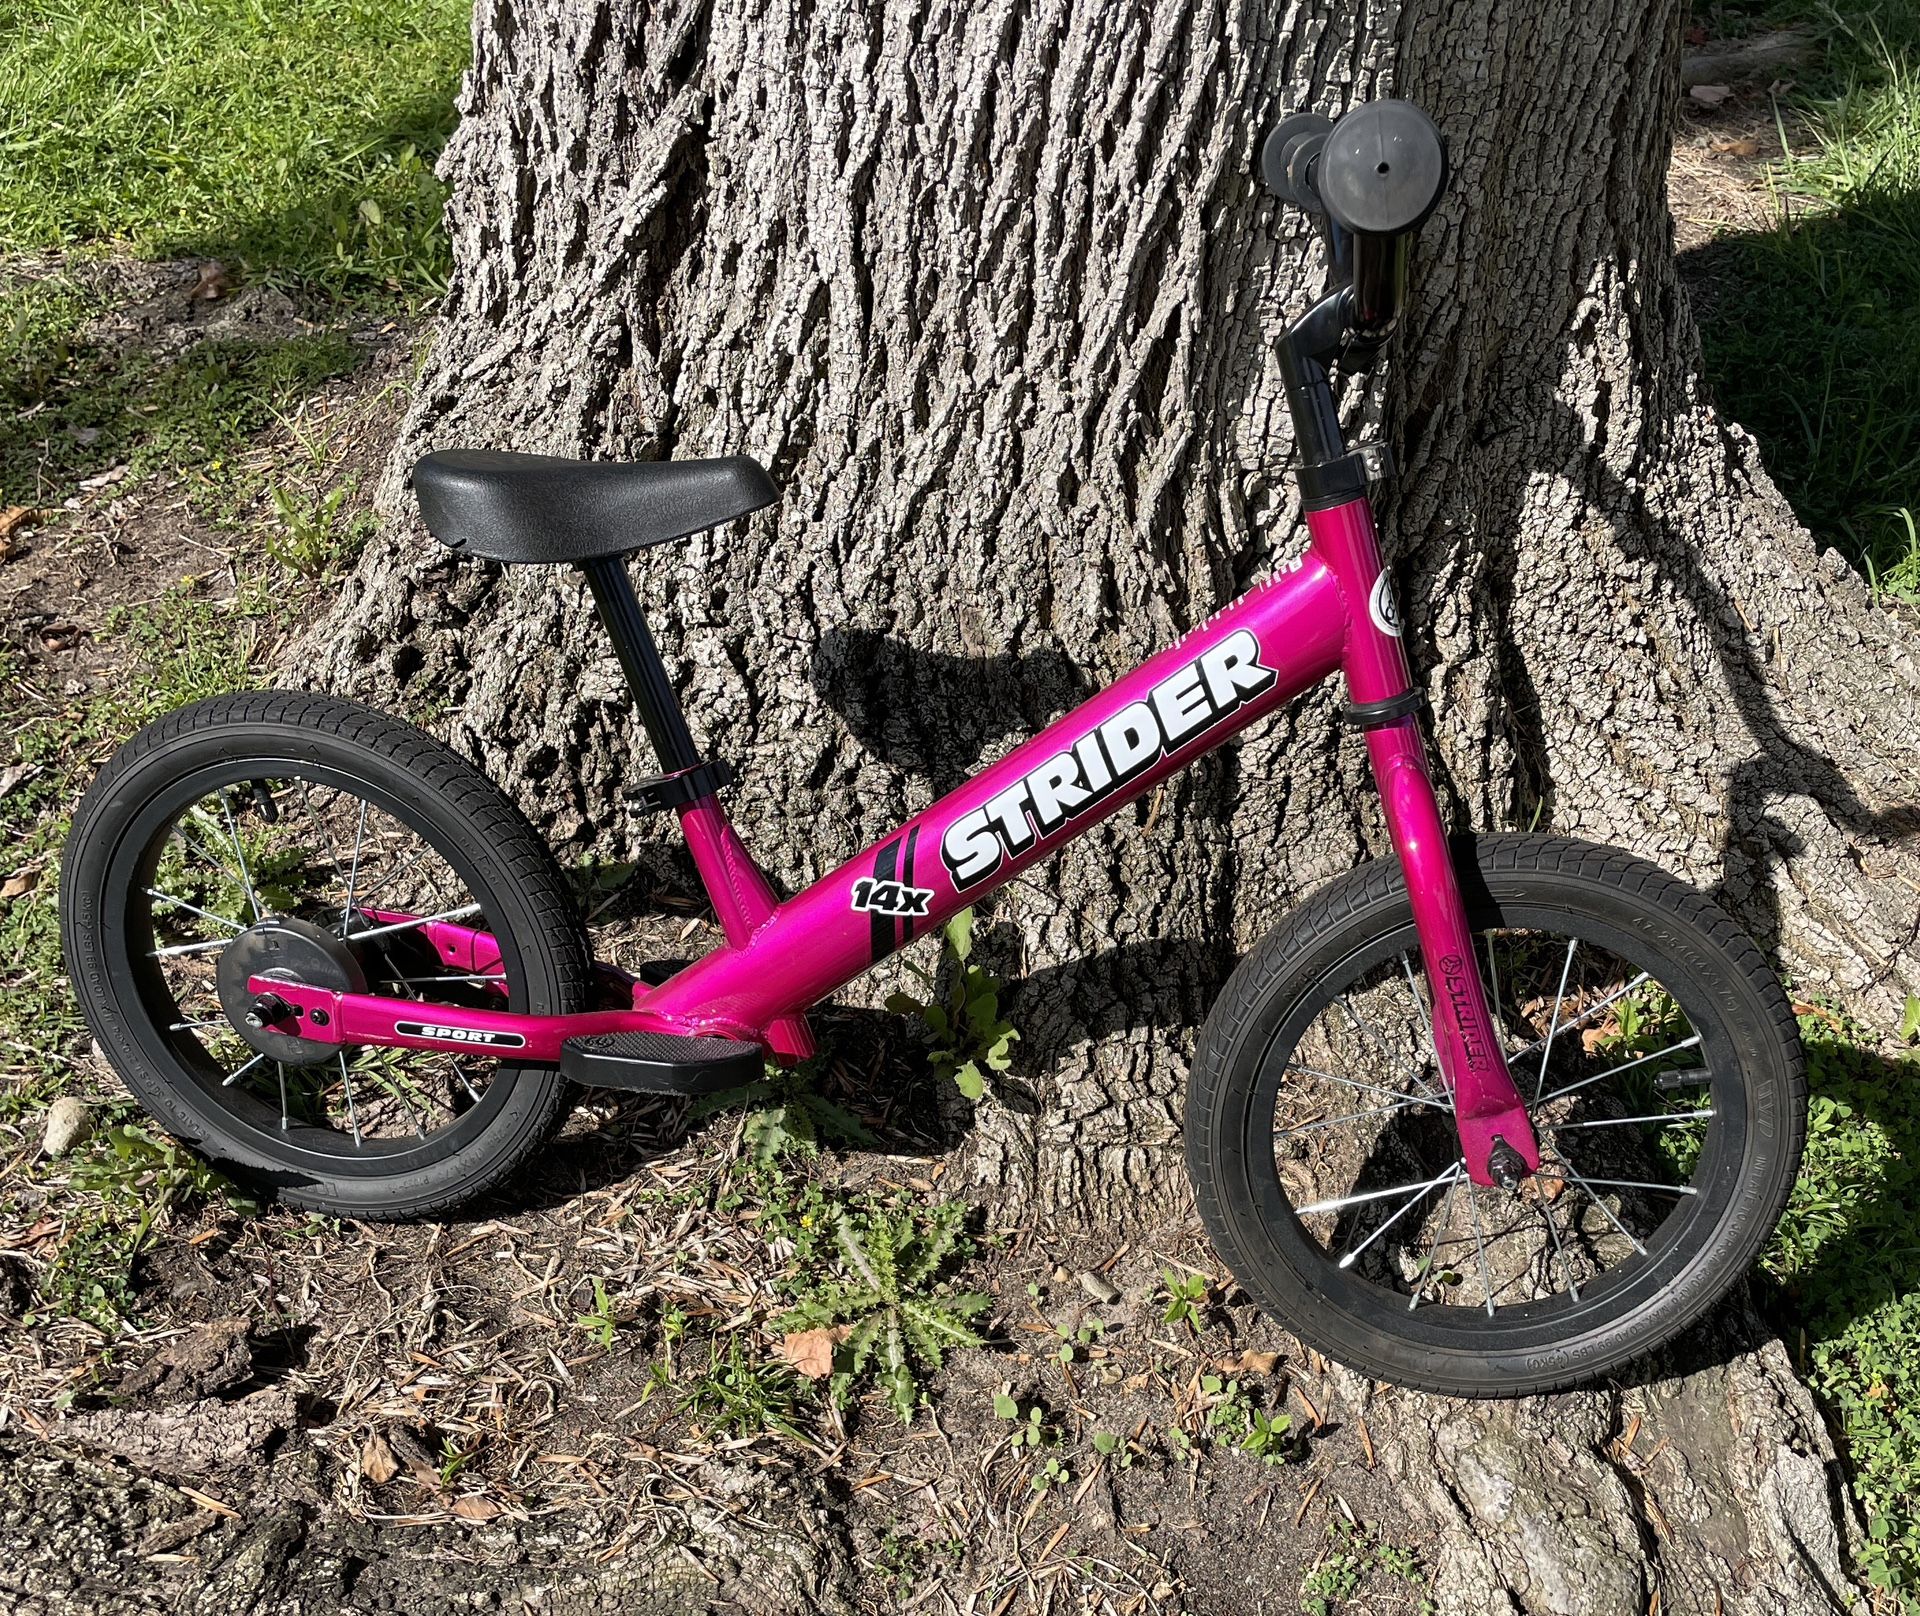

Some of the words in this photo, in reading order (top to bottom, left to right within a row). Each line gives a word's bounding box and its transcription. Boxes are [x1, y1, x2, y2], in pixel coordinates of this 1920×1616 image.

[943, 630, 1278, 891] STRIDER
[851, 876, 935, 916] 14x
[421, 1026, 496, 1043] SPORT
[1446, 976, 1490, 1074] STRIDER
[1571, 1343, 1596, 1361] LBS
[1596, 1337, 1613, 1351] 99
[1524, 1349, 1570, 1370] (45KG)
